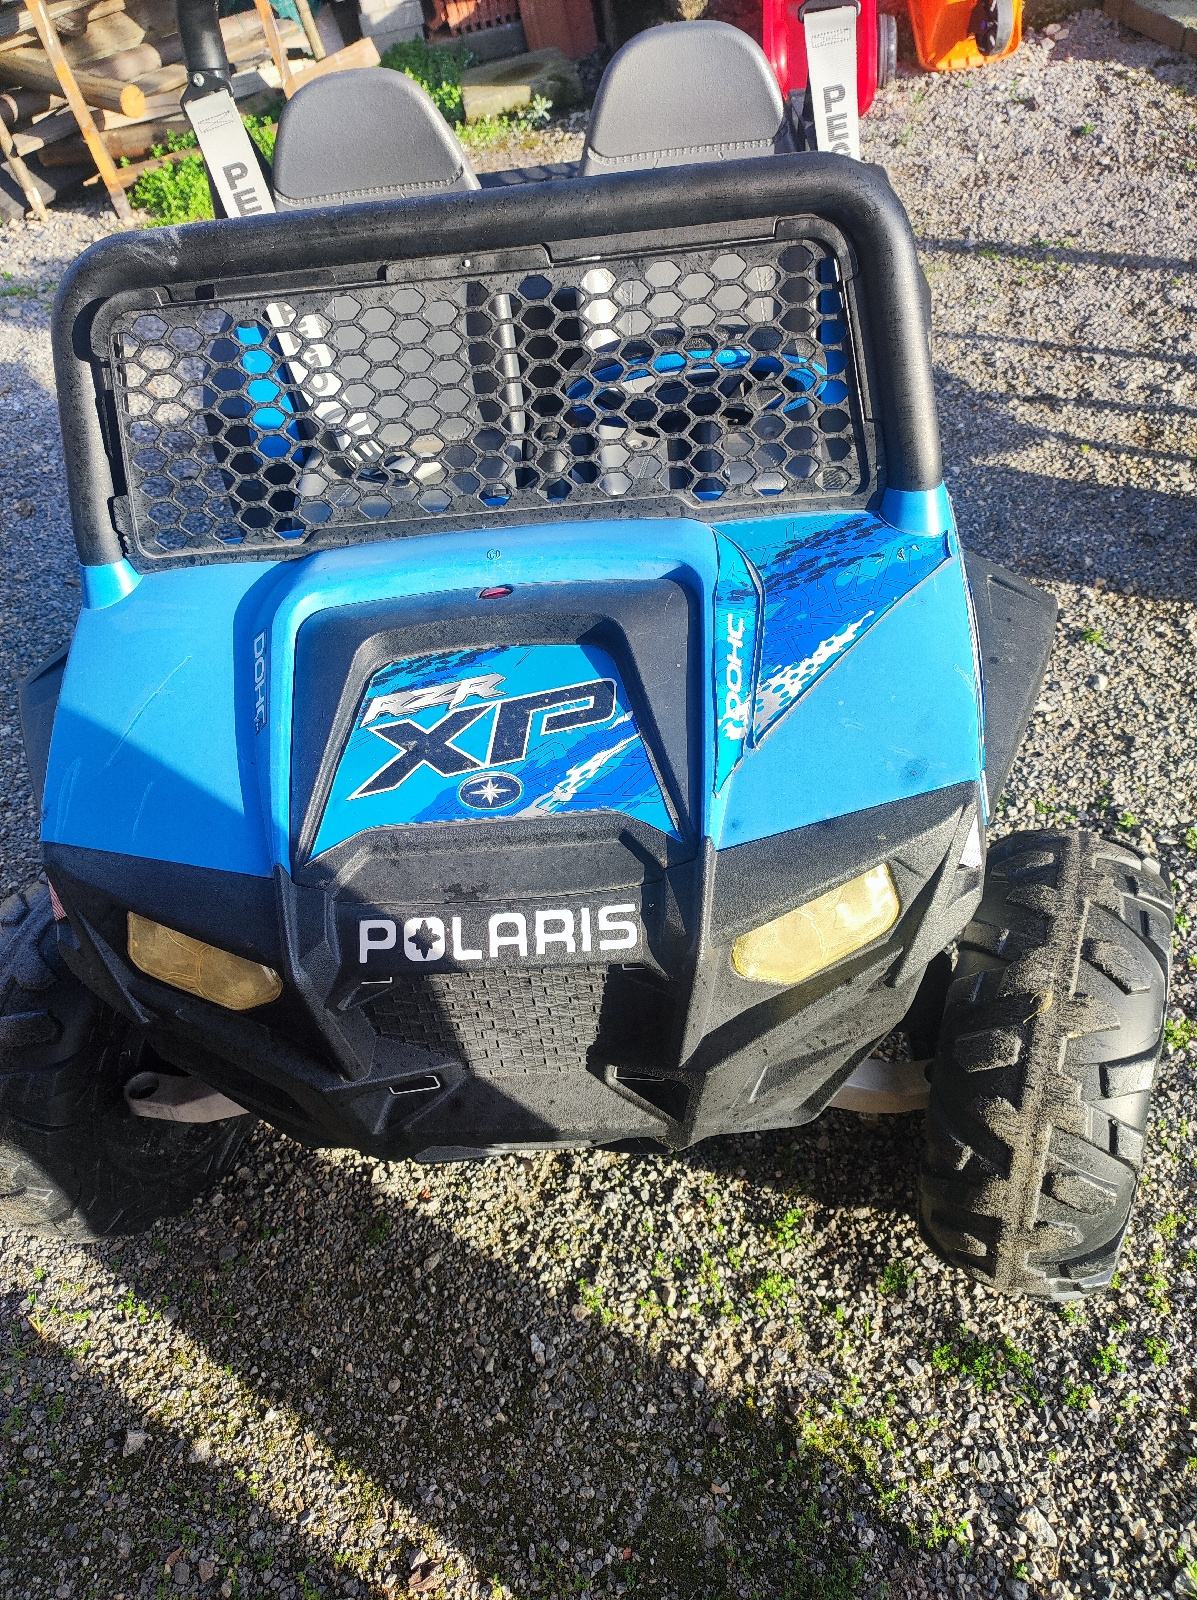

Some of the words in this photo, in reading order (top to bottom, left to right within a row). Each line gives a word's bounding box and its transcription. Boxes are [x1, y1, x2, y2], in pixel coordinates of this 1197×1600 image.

[358, 671, 508, 729] RZR
[343, 677, 618, 801] XP
[358, 902, 639, 964] POLARIS
